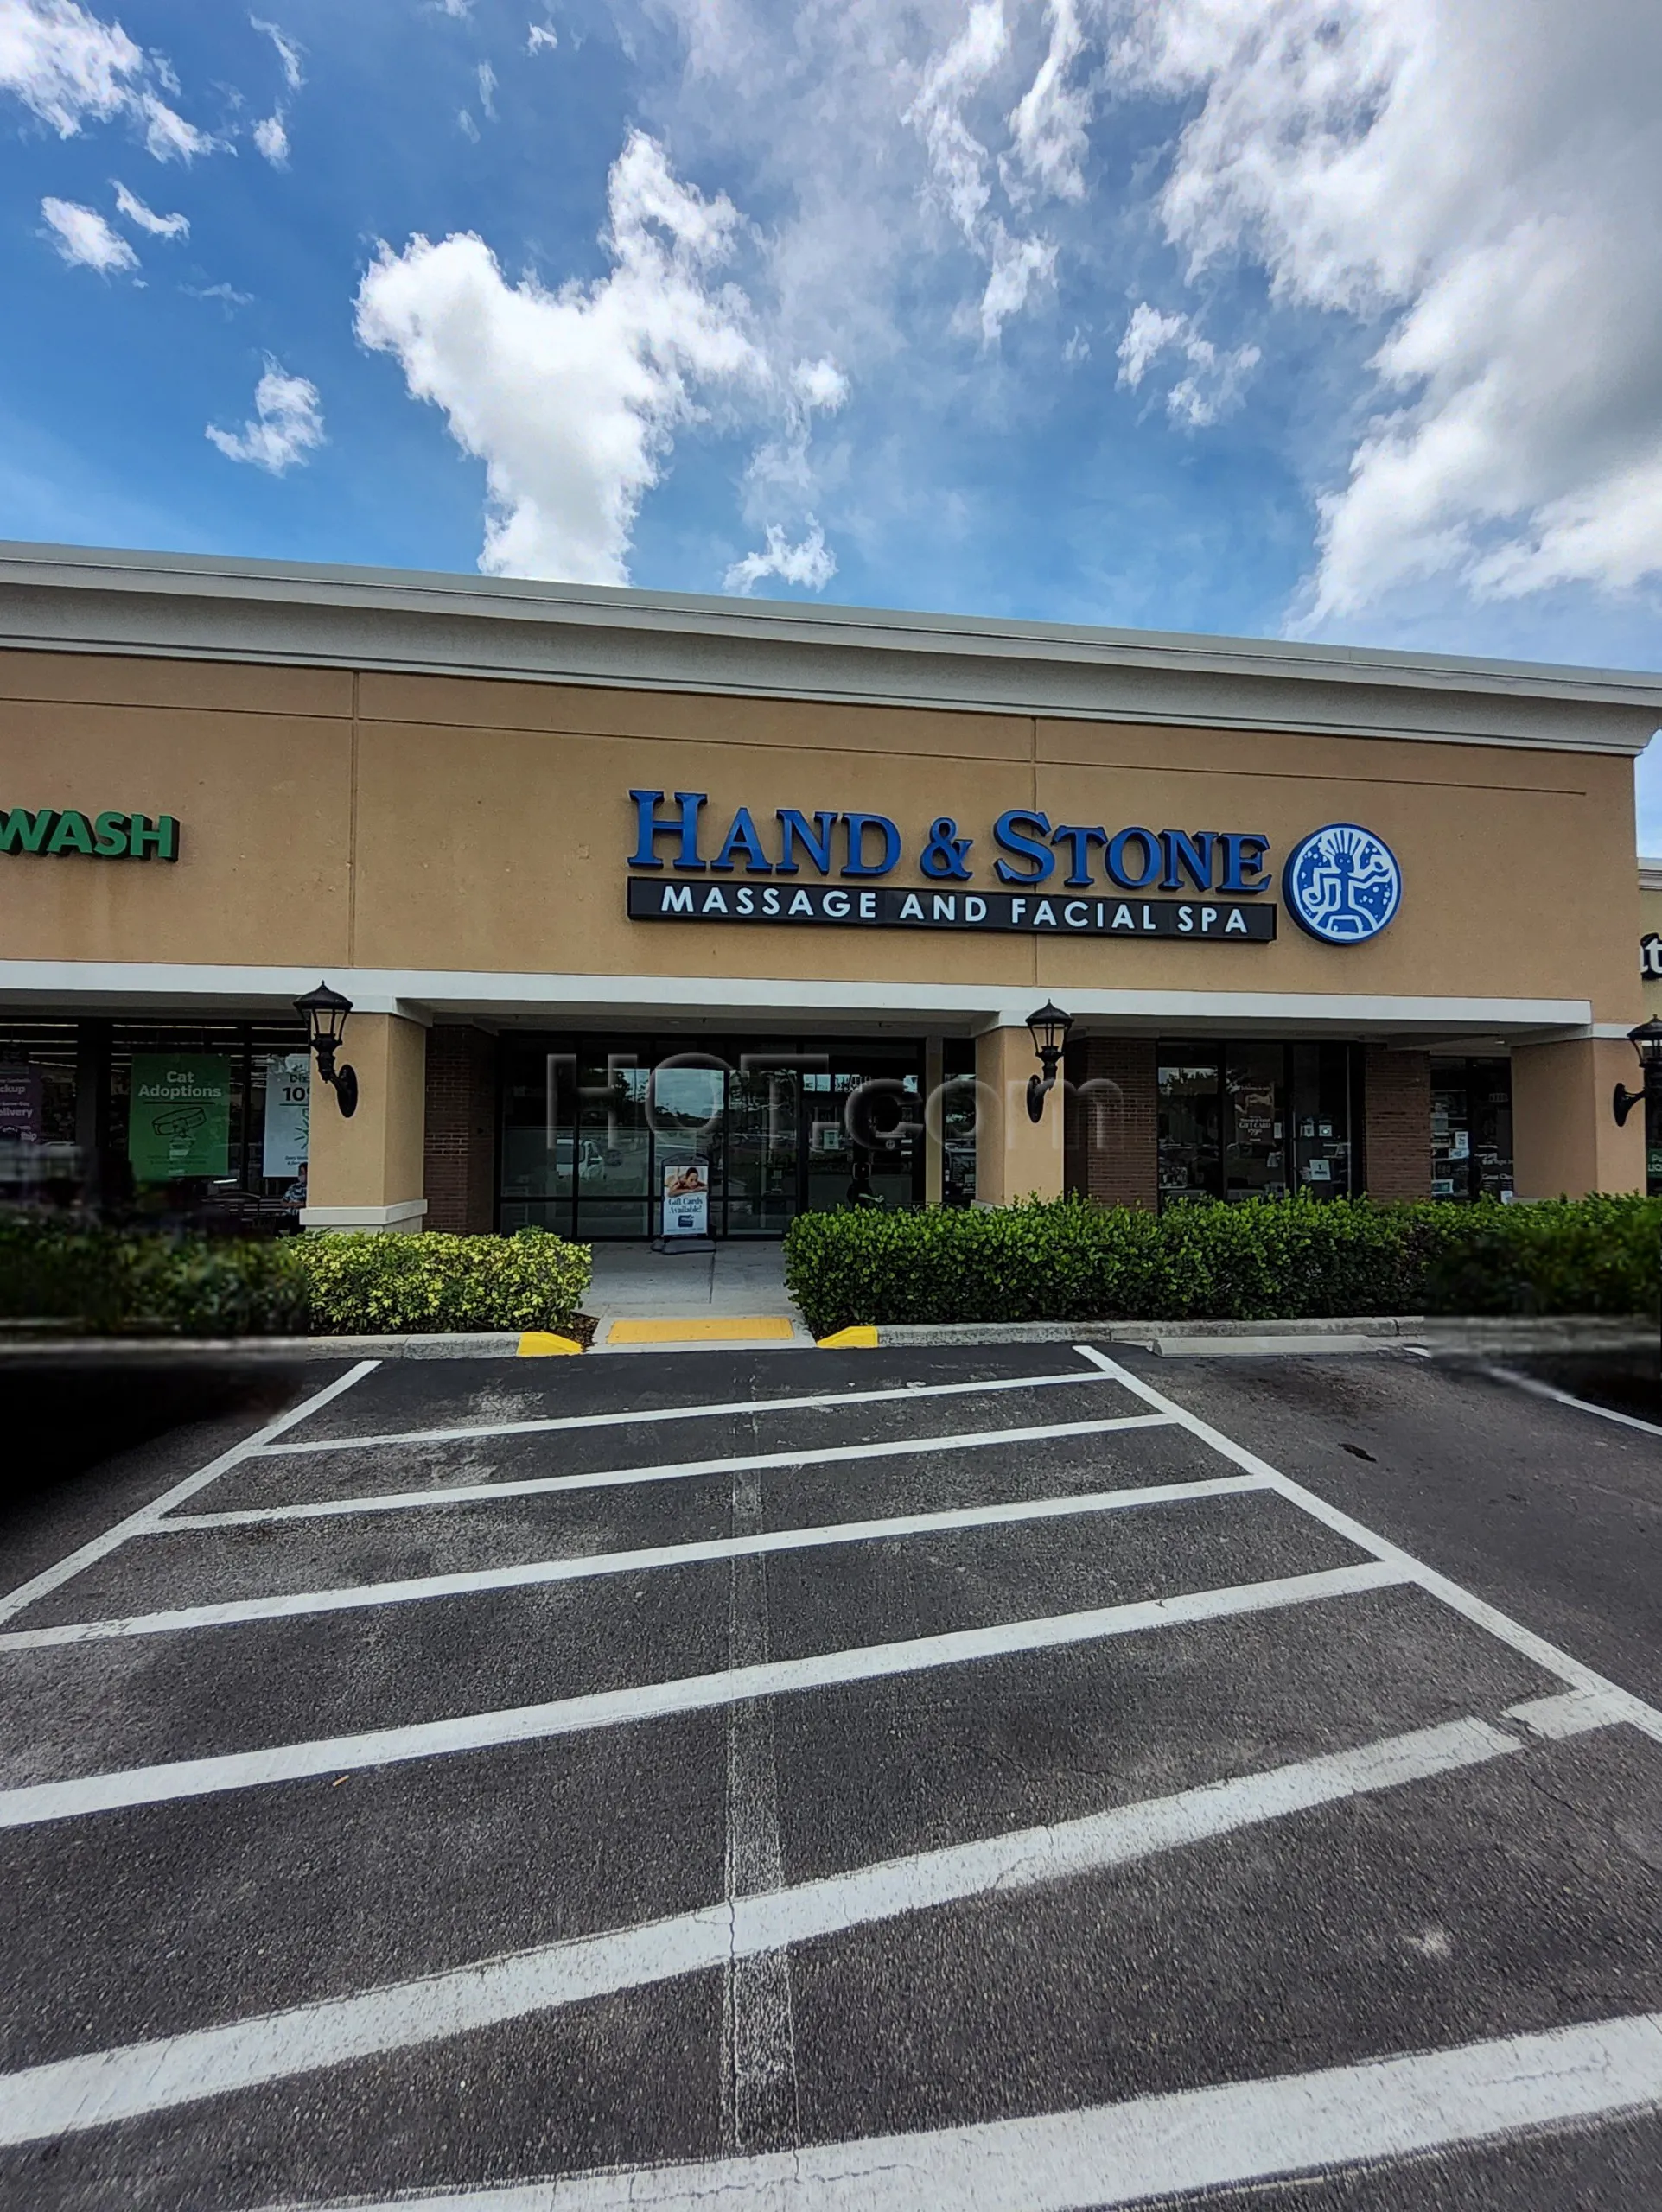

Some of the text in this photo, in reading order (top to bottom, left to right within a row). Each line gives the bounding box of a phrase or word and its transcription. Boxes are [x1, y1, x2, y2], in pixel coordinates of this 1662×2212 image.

[0, 808, 179, 862] WASH
[627, 789, 1273, 894] HAND & STONE
[660, 885, 1249, 934] MASSAGE AND FACIAL SPA
[165, 1070, 194, 1083] Cat
[137, 1084, 221, 1101] Adoptions
[283, 1086, 310, 1102] 10
[683, 1196, 703, 1205] Cards
